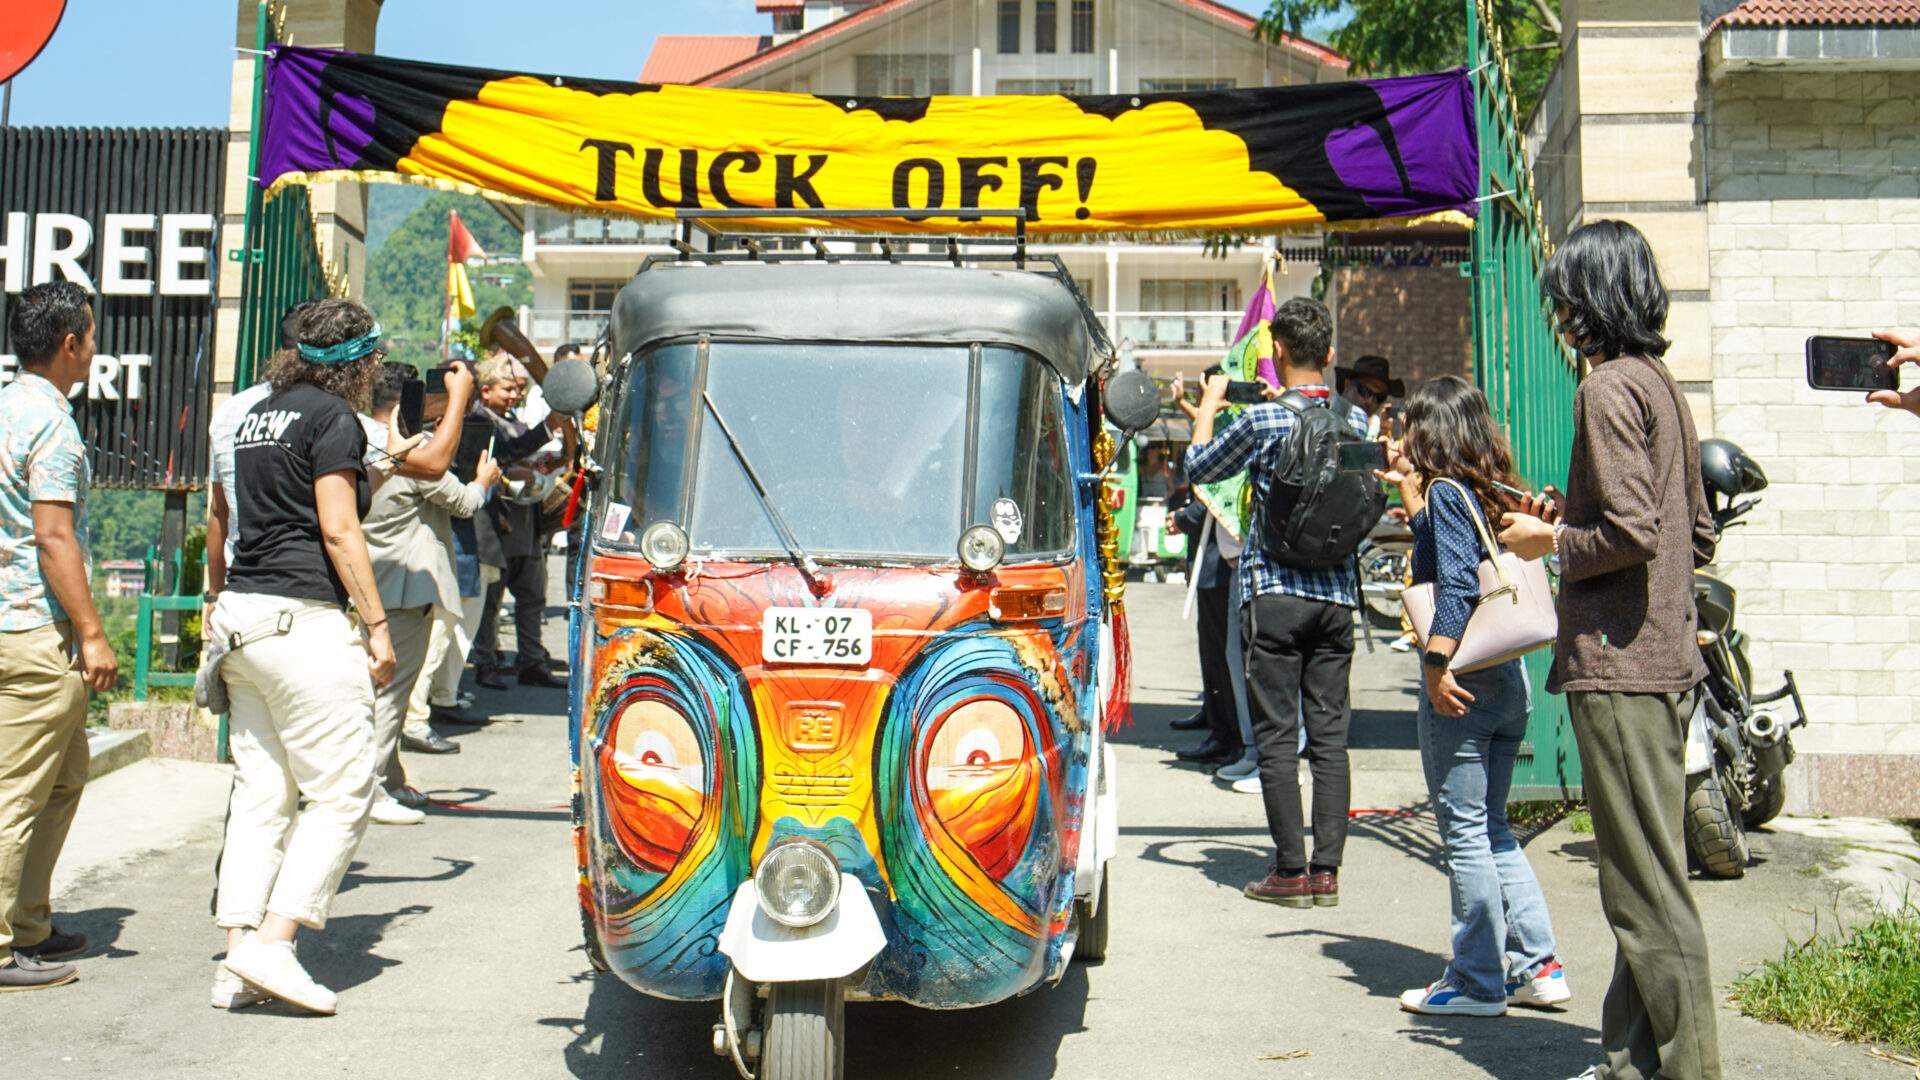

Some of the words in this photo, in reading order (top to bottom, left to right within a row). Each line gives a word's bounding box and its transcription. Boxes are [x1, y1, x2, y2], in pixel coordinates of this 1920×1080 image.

[579, 138, 828, 209] TUCK
[892, 156, 1097, 221] OFF!
[825, 616, 852, 635] 07
[823, 638, 862, 657] 756
